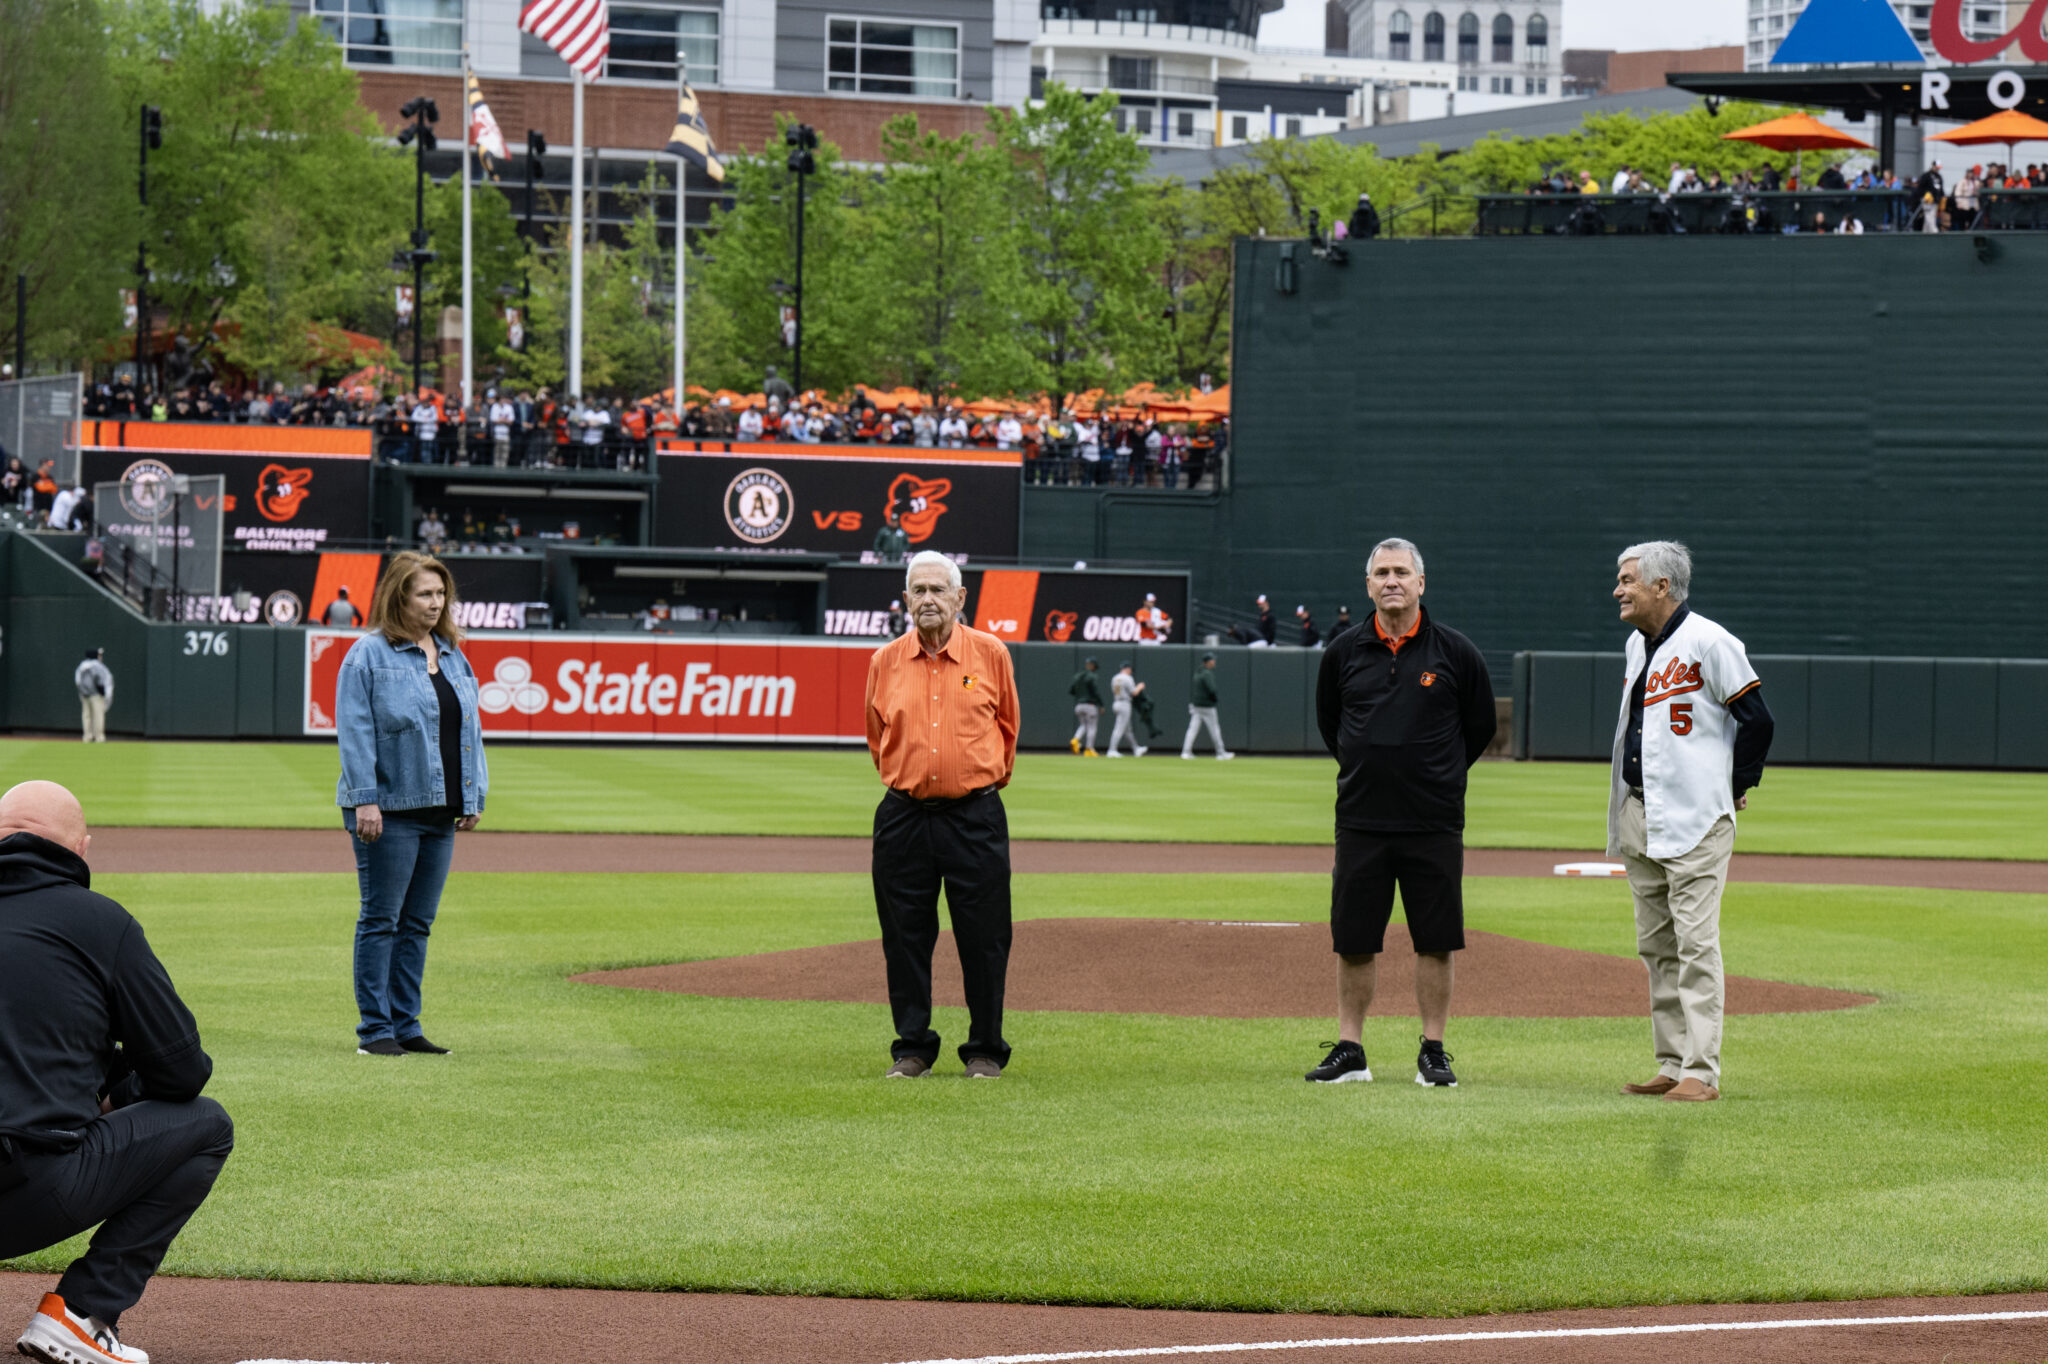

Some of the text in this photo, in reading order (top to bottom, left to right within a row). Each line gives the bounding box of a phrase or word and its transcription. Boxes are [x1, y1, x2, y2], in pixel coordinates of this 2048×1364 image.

[735, 472, 784, 495] OAKLAND
[234, 526, 328, 542] BALTIMORE
[733, 516, 784, 538] ATHLETICS
[183, 630, 229, 656] 376
[1669, 703, 1693, 736] 5
